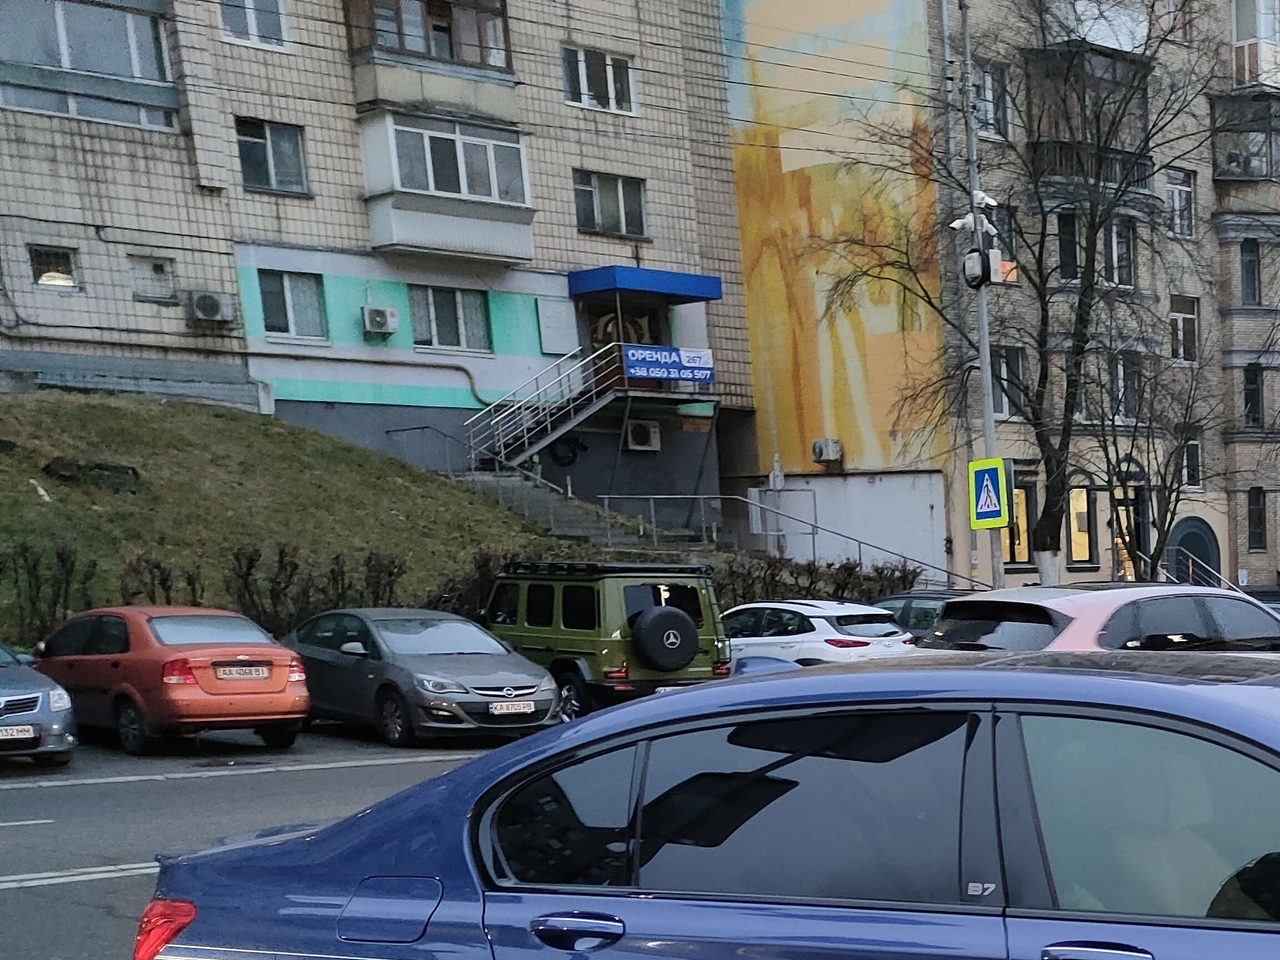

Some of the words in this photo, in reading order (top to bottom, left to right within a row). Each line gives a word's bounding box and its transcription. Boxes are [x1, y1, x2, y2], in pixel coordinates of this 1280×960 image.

[627, 349, 680, 364] ОРЕНДА
[685, 355, 702, 364] 267
[629, 366, 648, 377] +38
[648, 367, 667, 378] 050
[668, 368, 679, 378] 31
[680, 369, 693, 379] 05
[693, 370, 711, 380] 507
[494, 703, 503, 711] KA
[522, 702, 532, 710] PB
[967, 882, 996, 896] B7
